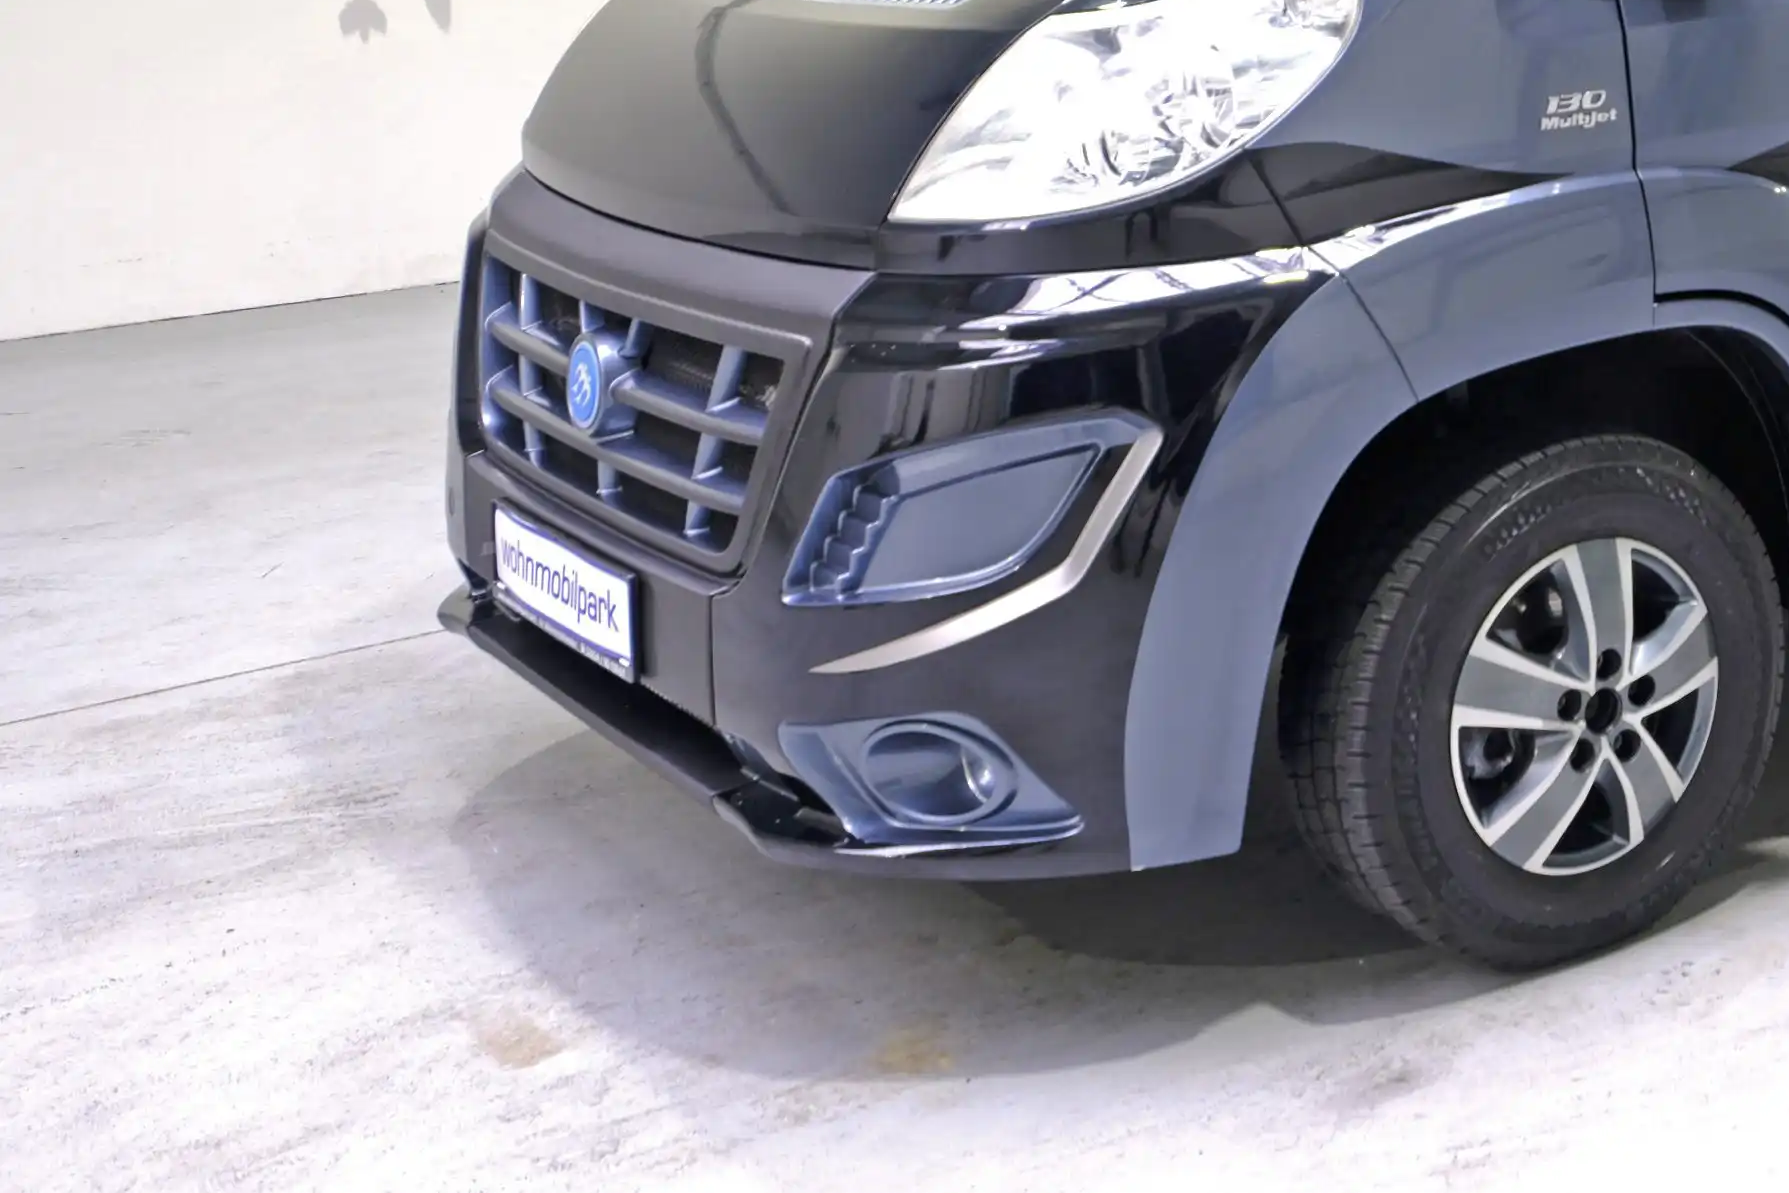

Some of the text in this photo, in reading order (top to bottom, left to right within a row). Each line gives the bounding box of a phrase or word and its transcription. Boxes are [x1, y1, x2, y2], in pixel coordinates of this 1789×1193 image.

[1546, 89, 1607, 114] 130
[1540, 108, 1617, 130] Multijet
[502, 539, 619, 632] wohnmobilpark
